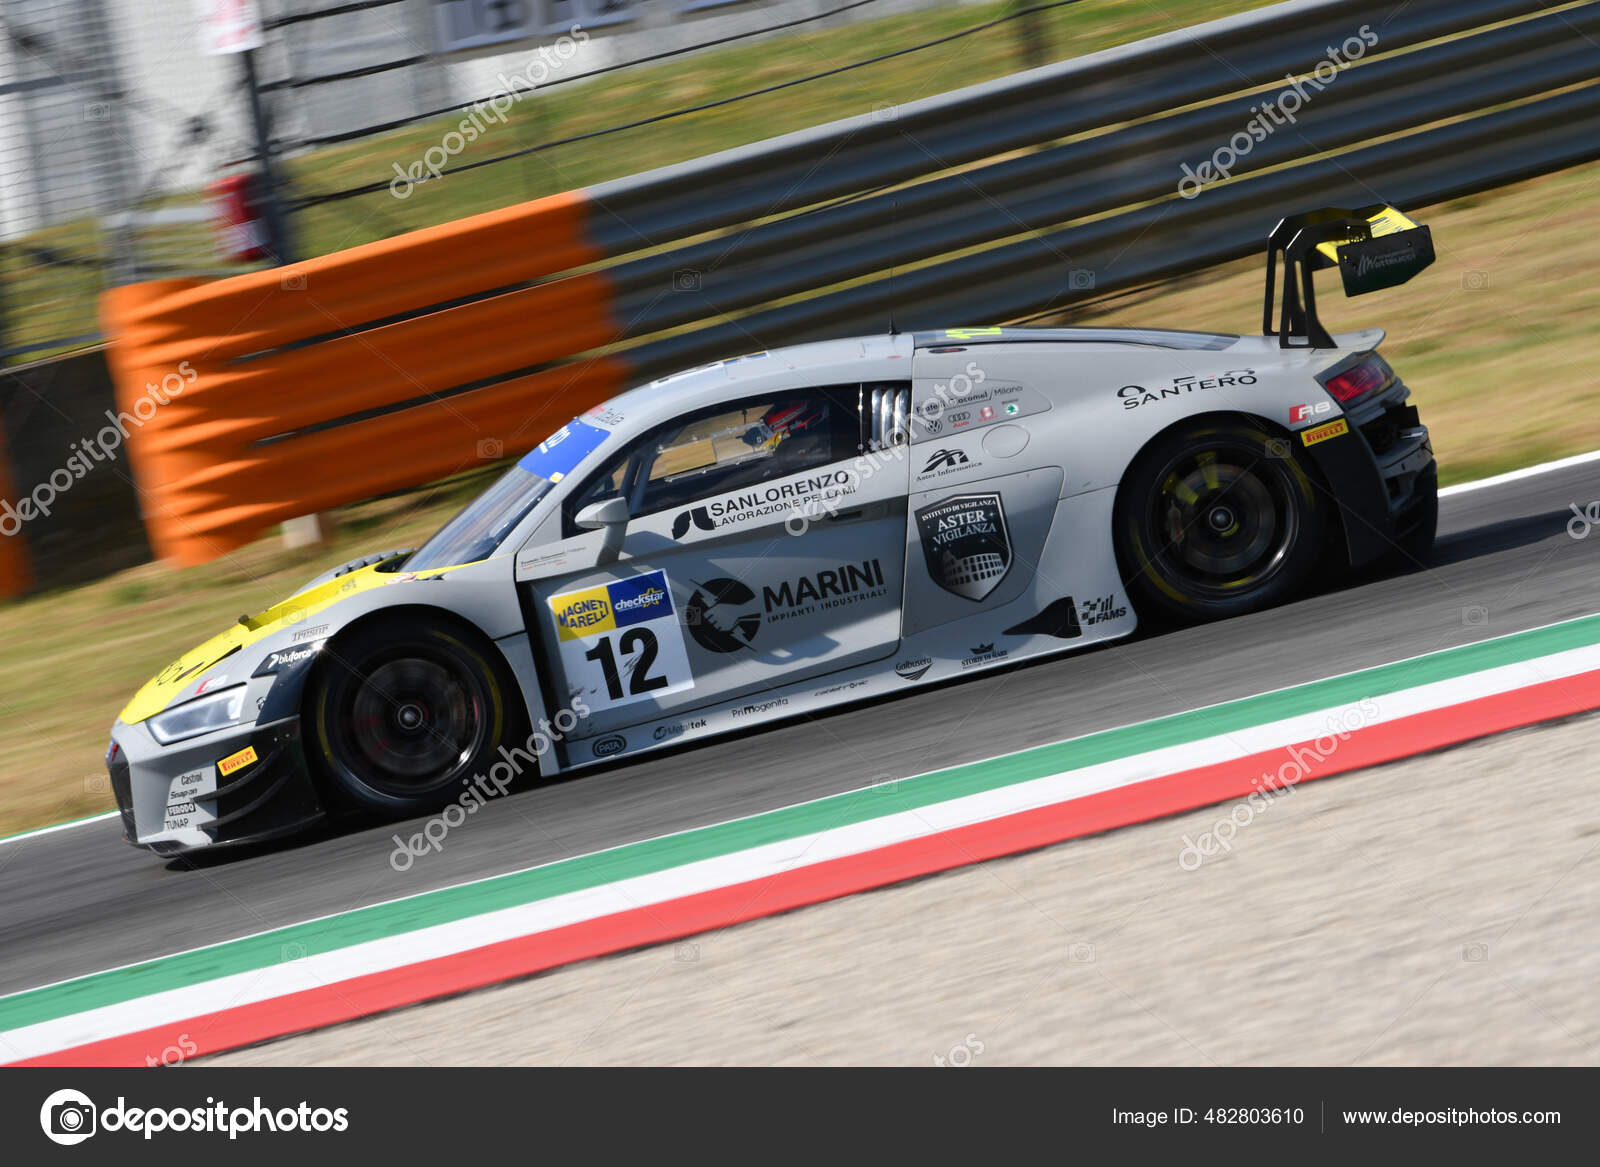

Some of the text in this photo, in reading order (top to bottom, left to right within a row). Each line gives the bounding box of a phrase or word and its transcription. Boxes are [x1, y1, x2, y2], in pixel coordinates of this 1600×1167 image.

[1122, 374, 1258, 410] SANTERO
[1306, 422, 1345, 443] PIRELLI
[711, 470, 850, 517] SANLORENZO
[714, 498, 801, 528] LAVORAZIONE
[921, 506, 952, 521] ISTITUTO
[937, 509, 987, 532] ASTER
[932, 522, 997, 545] VIGILANZA
[762, 558, 885, 613] MARINI
[614, 590, 665, 611] checkstar
[767, 588, 888, 624] IMPIANTI INDUSTRIALI
[585, 627, 669, 700] 12
[599, 740, 620, 753] PATA
[168, 803, 195, 817] FERODO
[165, 818, 189, 831] TUNAP
